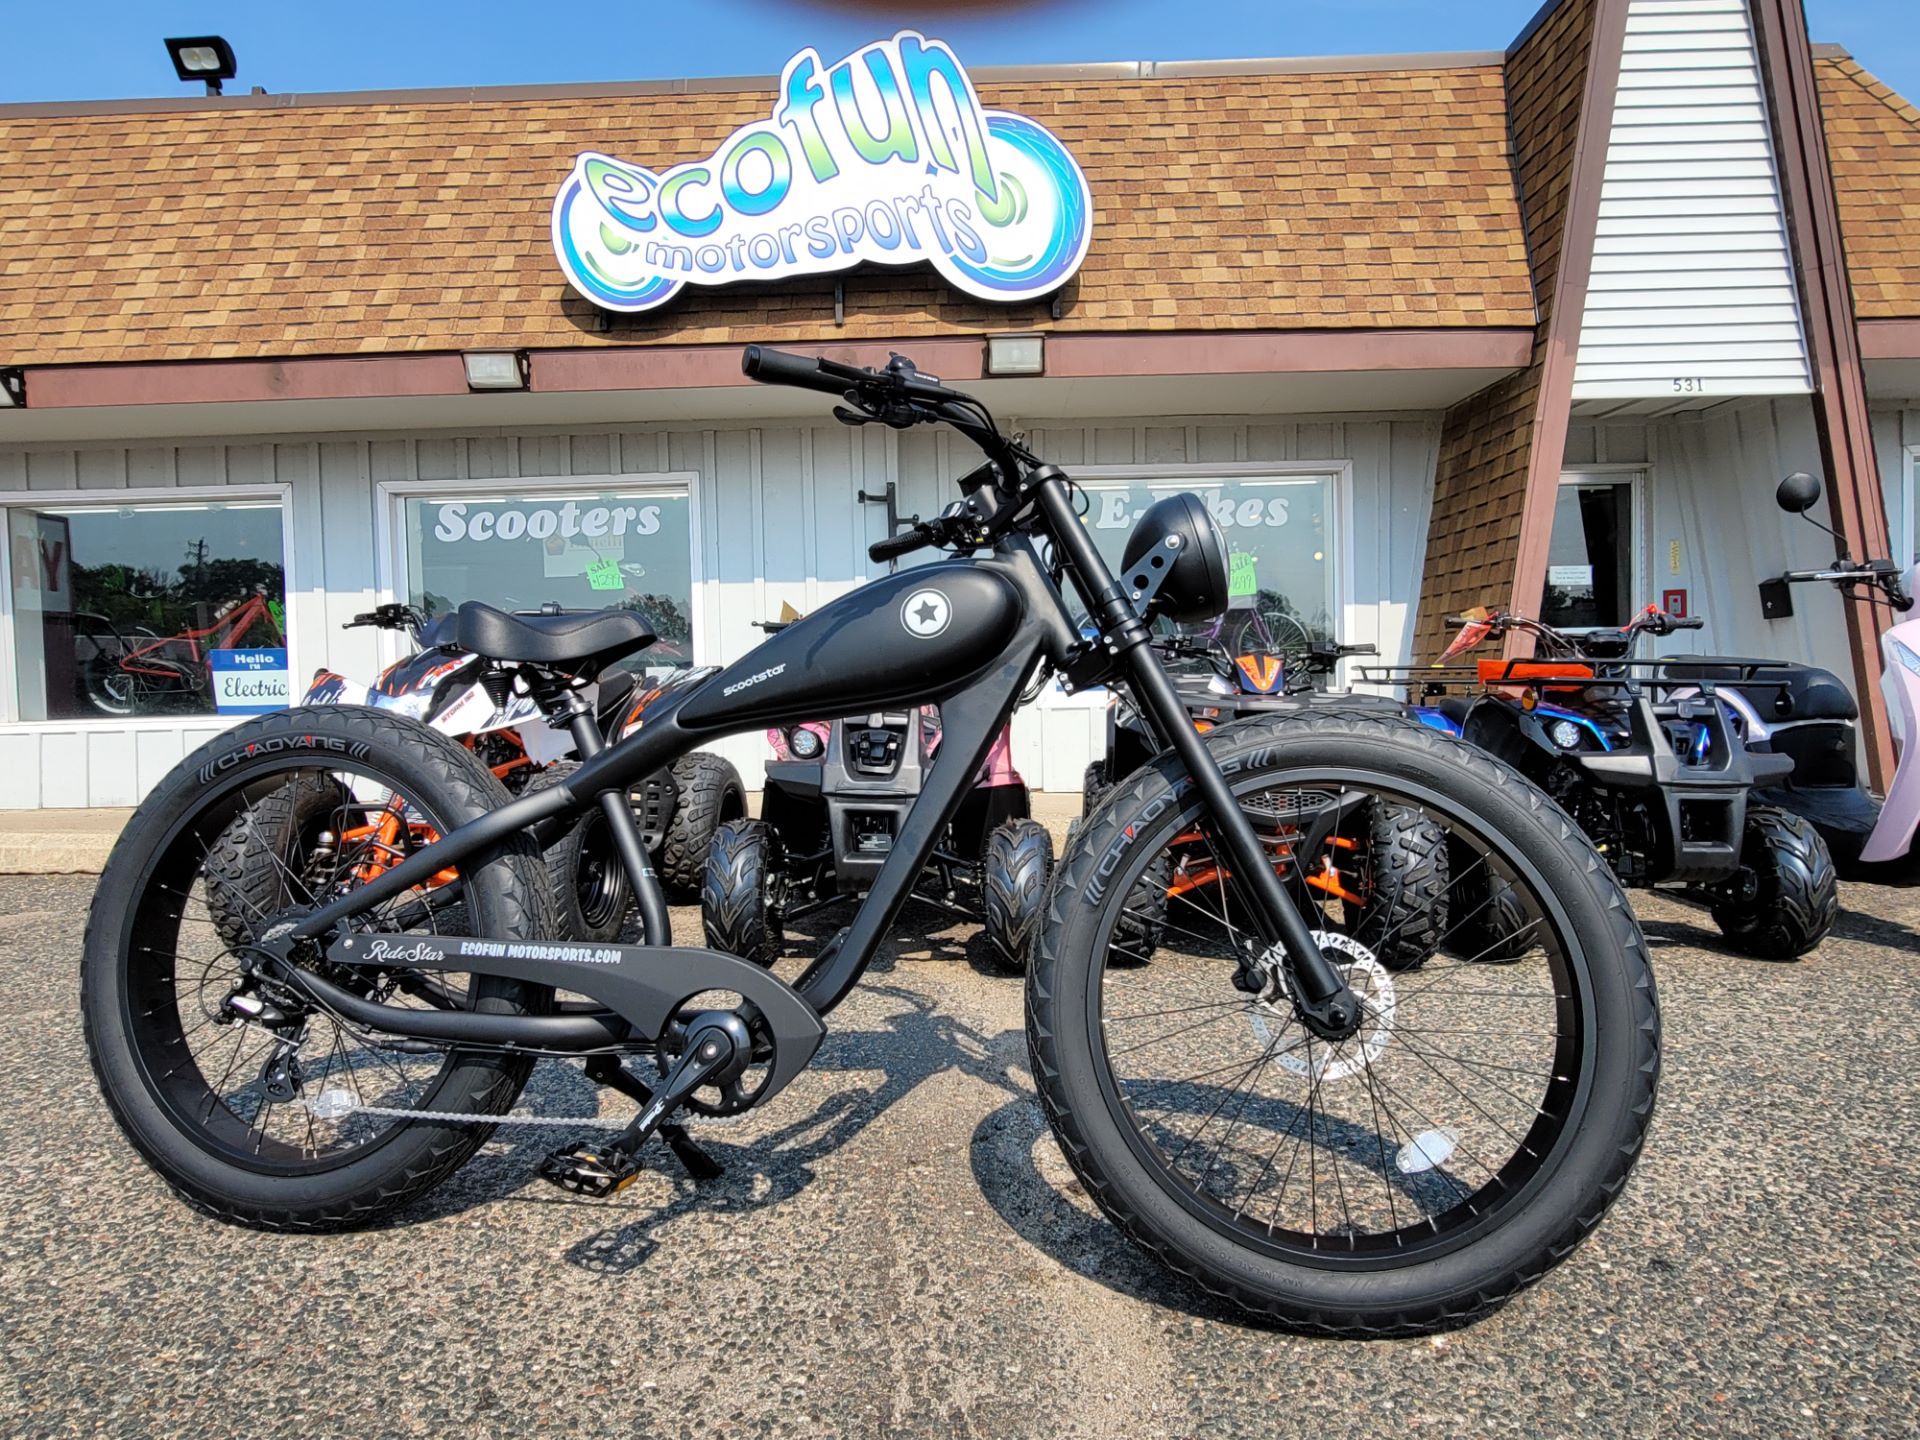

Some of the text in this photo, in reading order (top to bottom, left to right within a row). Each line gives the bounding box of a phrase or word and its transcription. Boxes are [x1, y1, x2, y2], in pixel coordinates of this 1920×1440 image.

[585, 36, 999, 233] ecofun
[646, 184, 988, 273] motorsports
[1672, 377, 1704, 393] 531
[434, 501, 661, 543] Scooters
[1096, 487, 1289, 528] E-kes
[234, 653, 275, 664] Hello
[723, 663, 787, 697] scootstar
[441, 701, 465, 724] STORM
[217, 735, 347, 771] CHAOYANG
[459, 942, 505, 957] ECOFUN
[507, 943, 622, 965] MOTORSPORTS.COM
